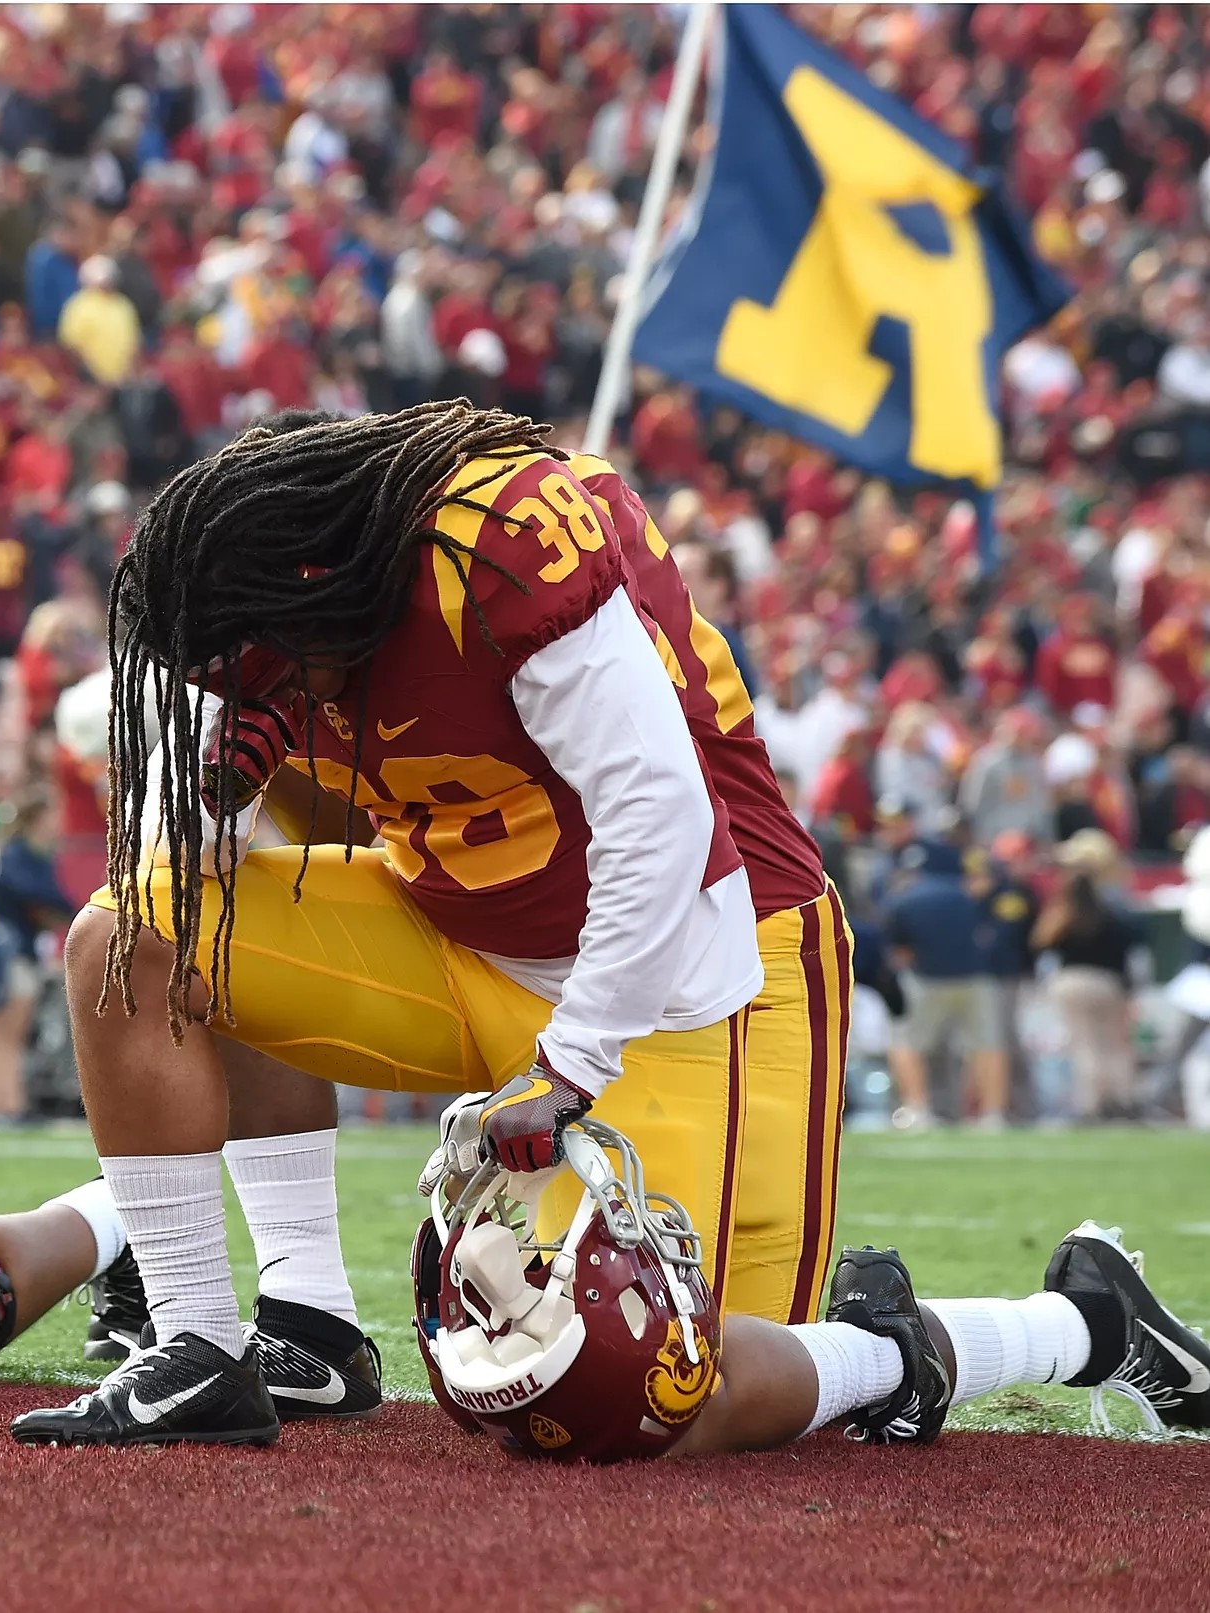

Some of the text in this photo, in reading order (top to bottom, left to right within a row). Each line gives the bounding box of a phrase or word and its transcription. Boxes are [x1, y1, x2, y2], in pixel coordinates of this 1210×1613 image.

[503, 472, 606, 583] 38
[322, 701, 355, 741] SC
[449, 1372, 544, 1411] TROJANS
